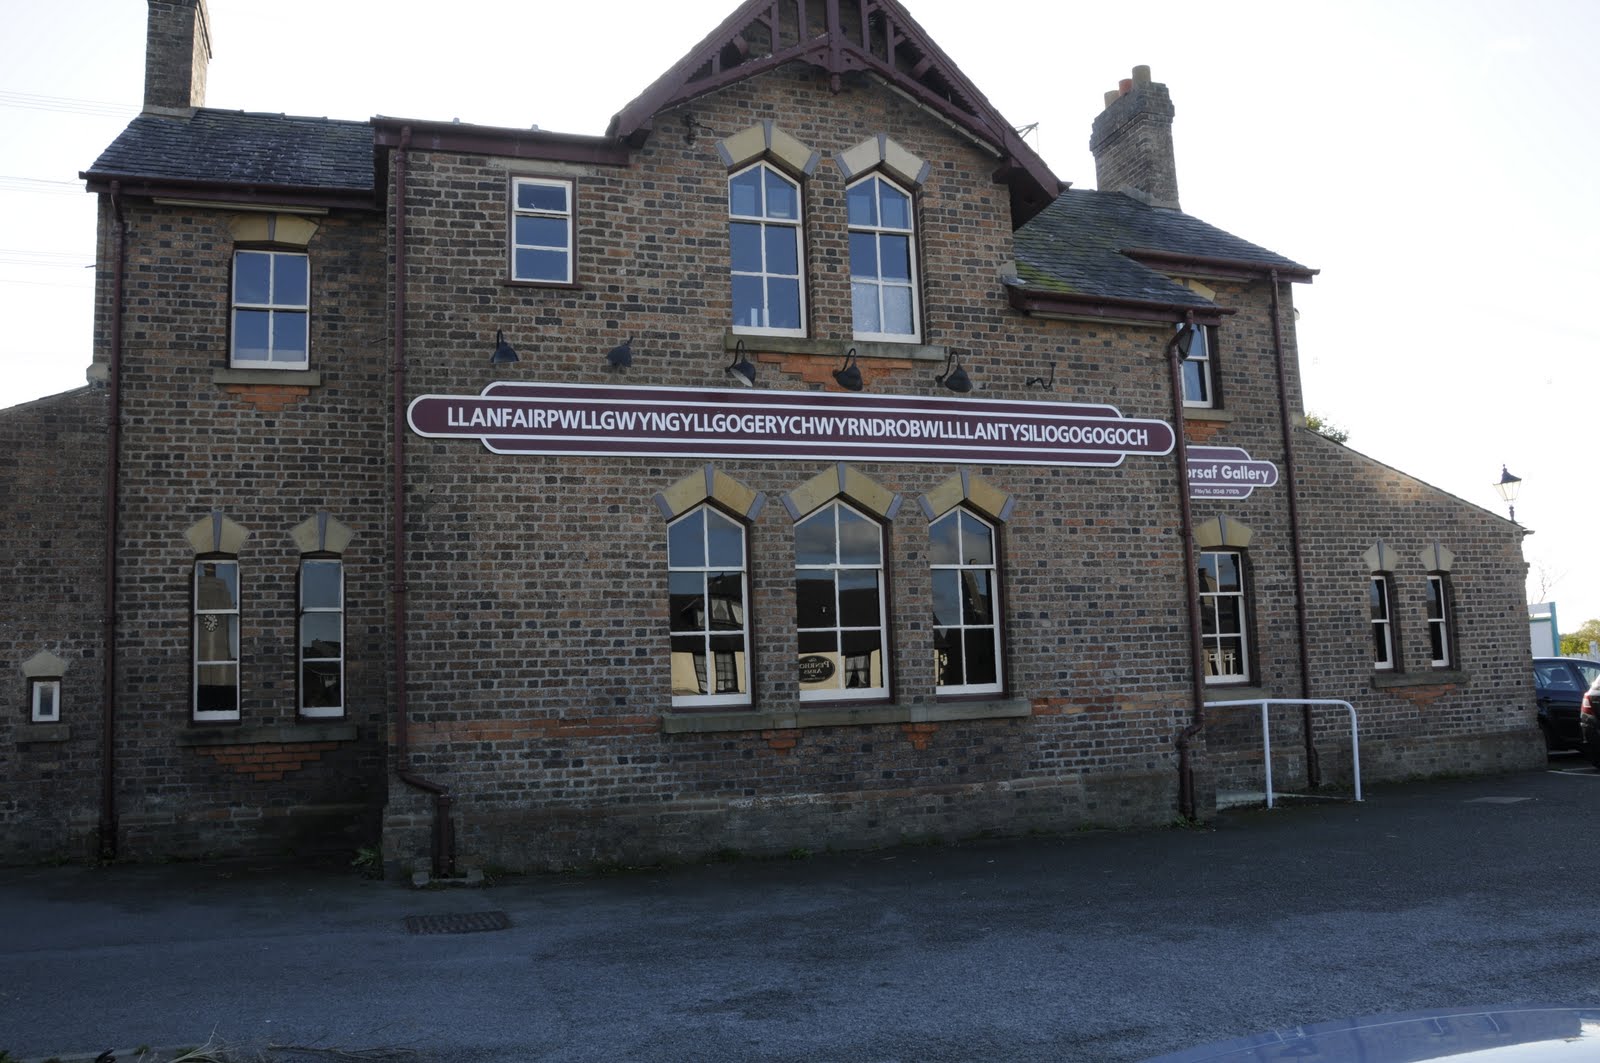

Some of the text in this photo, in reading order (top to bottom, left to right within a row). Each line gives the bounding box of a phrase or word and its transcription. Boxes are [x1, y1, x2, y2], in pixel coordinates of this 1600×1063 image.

[447, 407, 1148, 446] LLANFAIRPWLLGWYNGYLLGOGERYCHWYRNDROBWLLLLANTYSILIOGOGOGOCH
[1188, 465, 1269, 483] rsaf Gallery
